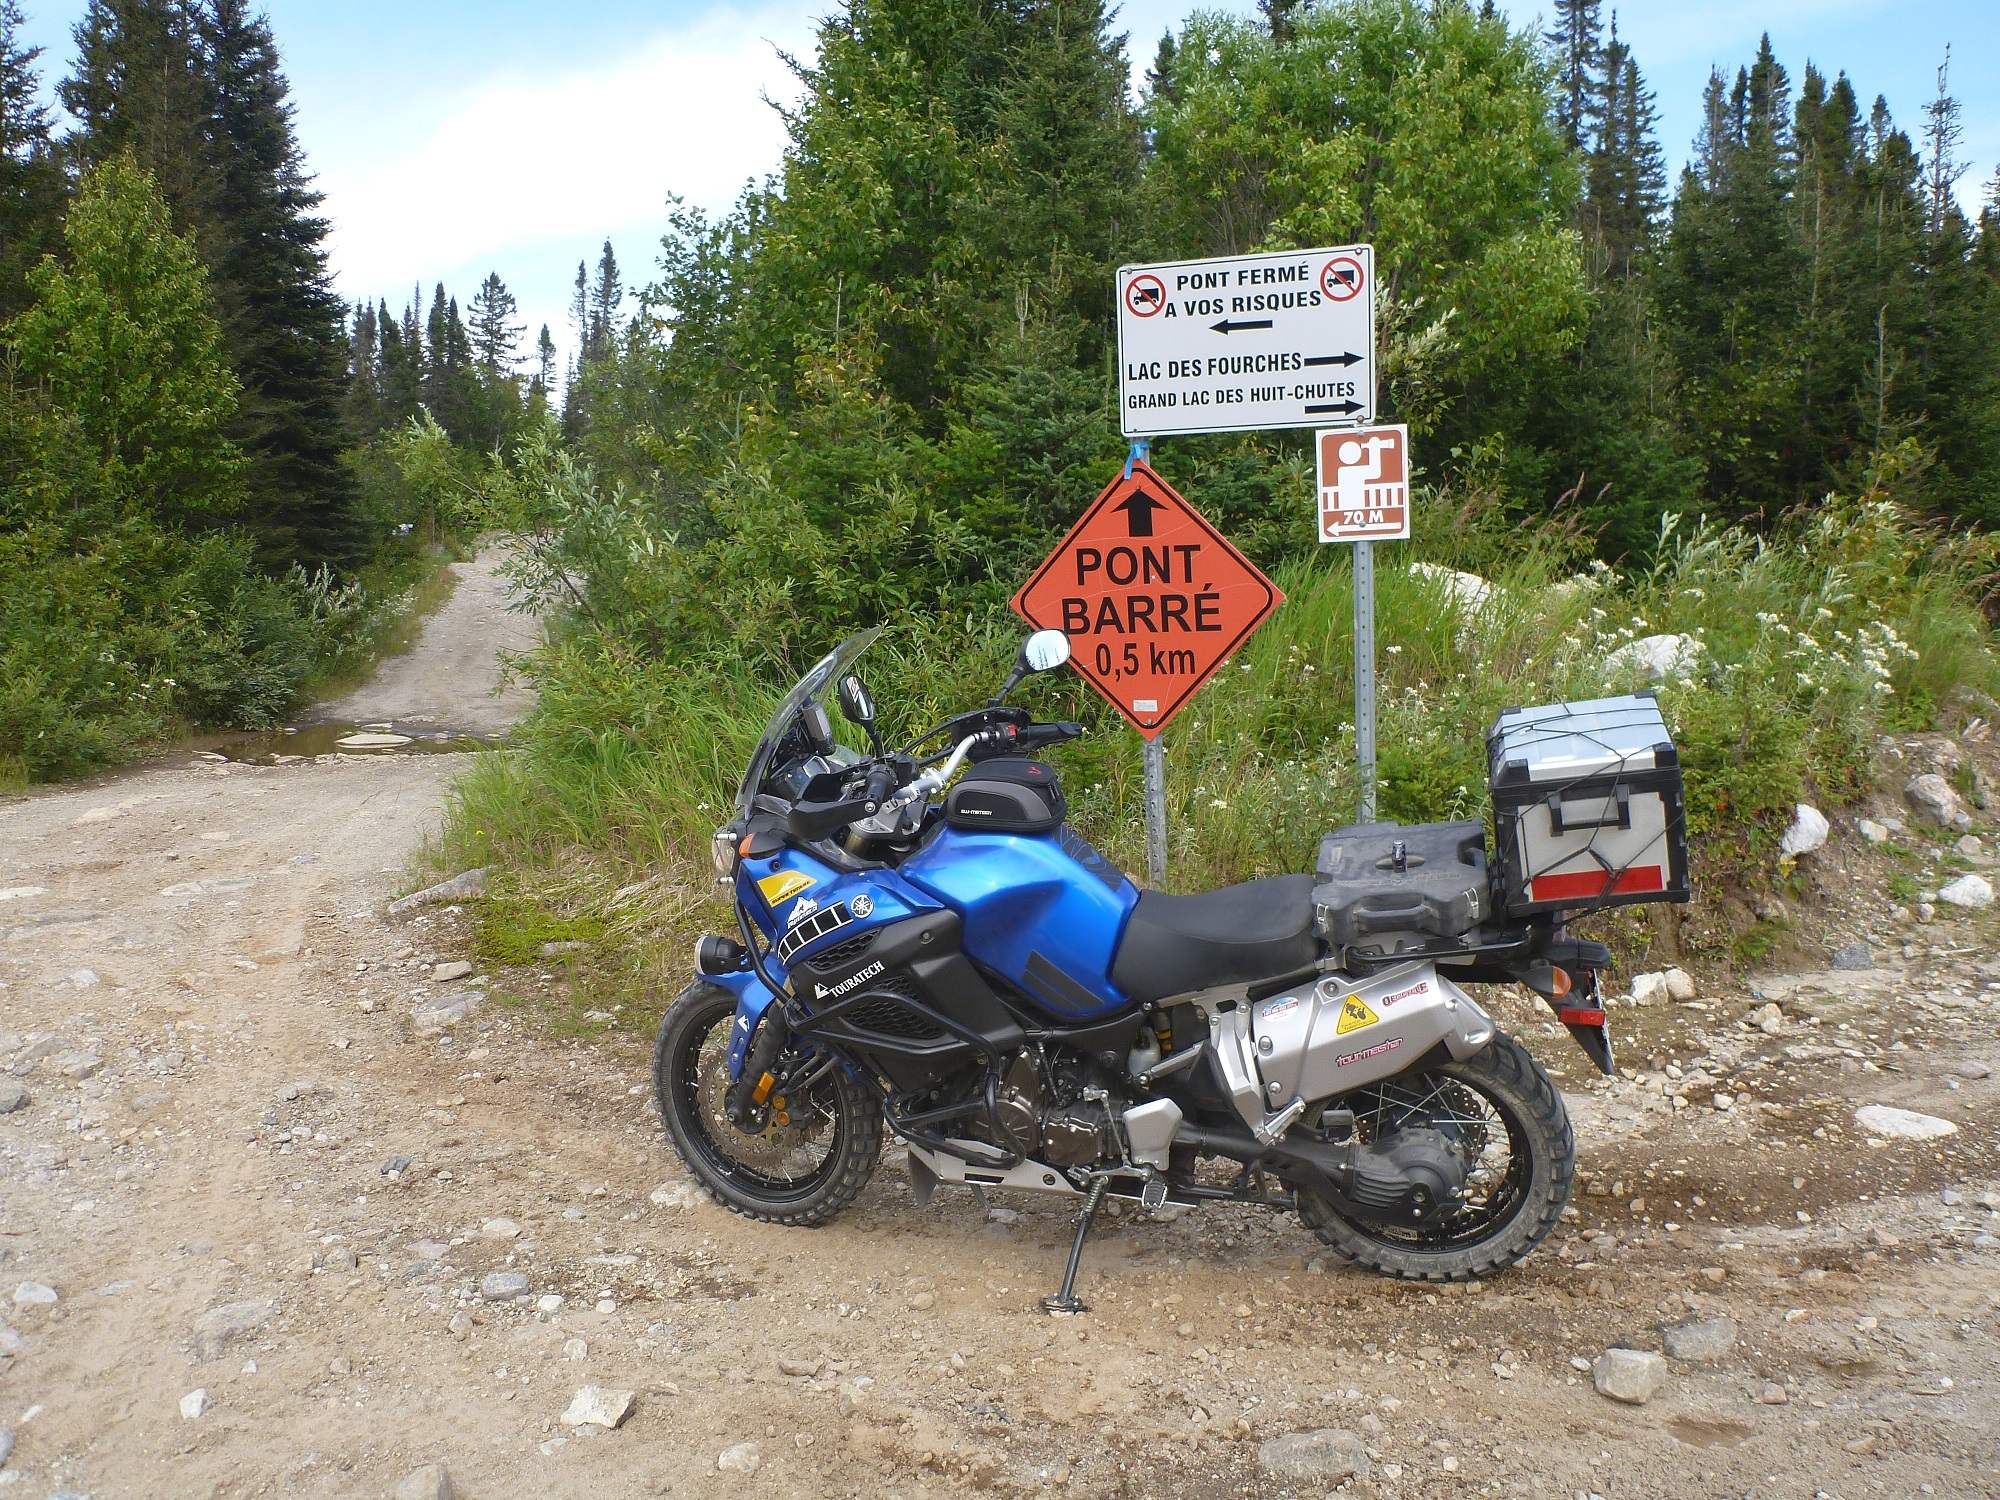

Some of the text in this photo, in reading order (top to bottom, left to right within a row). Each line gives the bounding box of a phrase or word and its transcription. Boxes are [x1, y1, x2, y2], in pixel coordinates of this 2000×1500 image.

[1177, 261, 1309, 291] PONT FERMÉ
[1164, 290, 1322, 318] A VOS RISQUES
[1128, 352, 1302, 381] LAC DES FOURCHES
[1128, 382, 1355, 409] GRAND LAC DES HUIT-CHUTES
[1343, 510, 1384, 525] 70 M
[1076, 544, 1201, 586] PONT
[1061, 583, 1223, 635] BARRÉ
[1095, 642, 1195, 682] 0,5 km
[829, 960, 886, 998] TOURATECH
